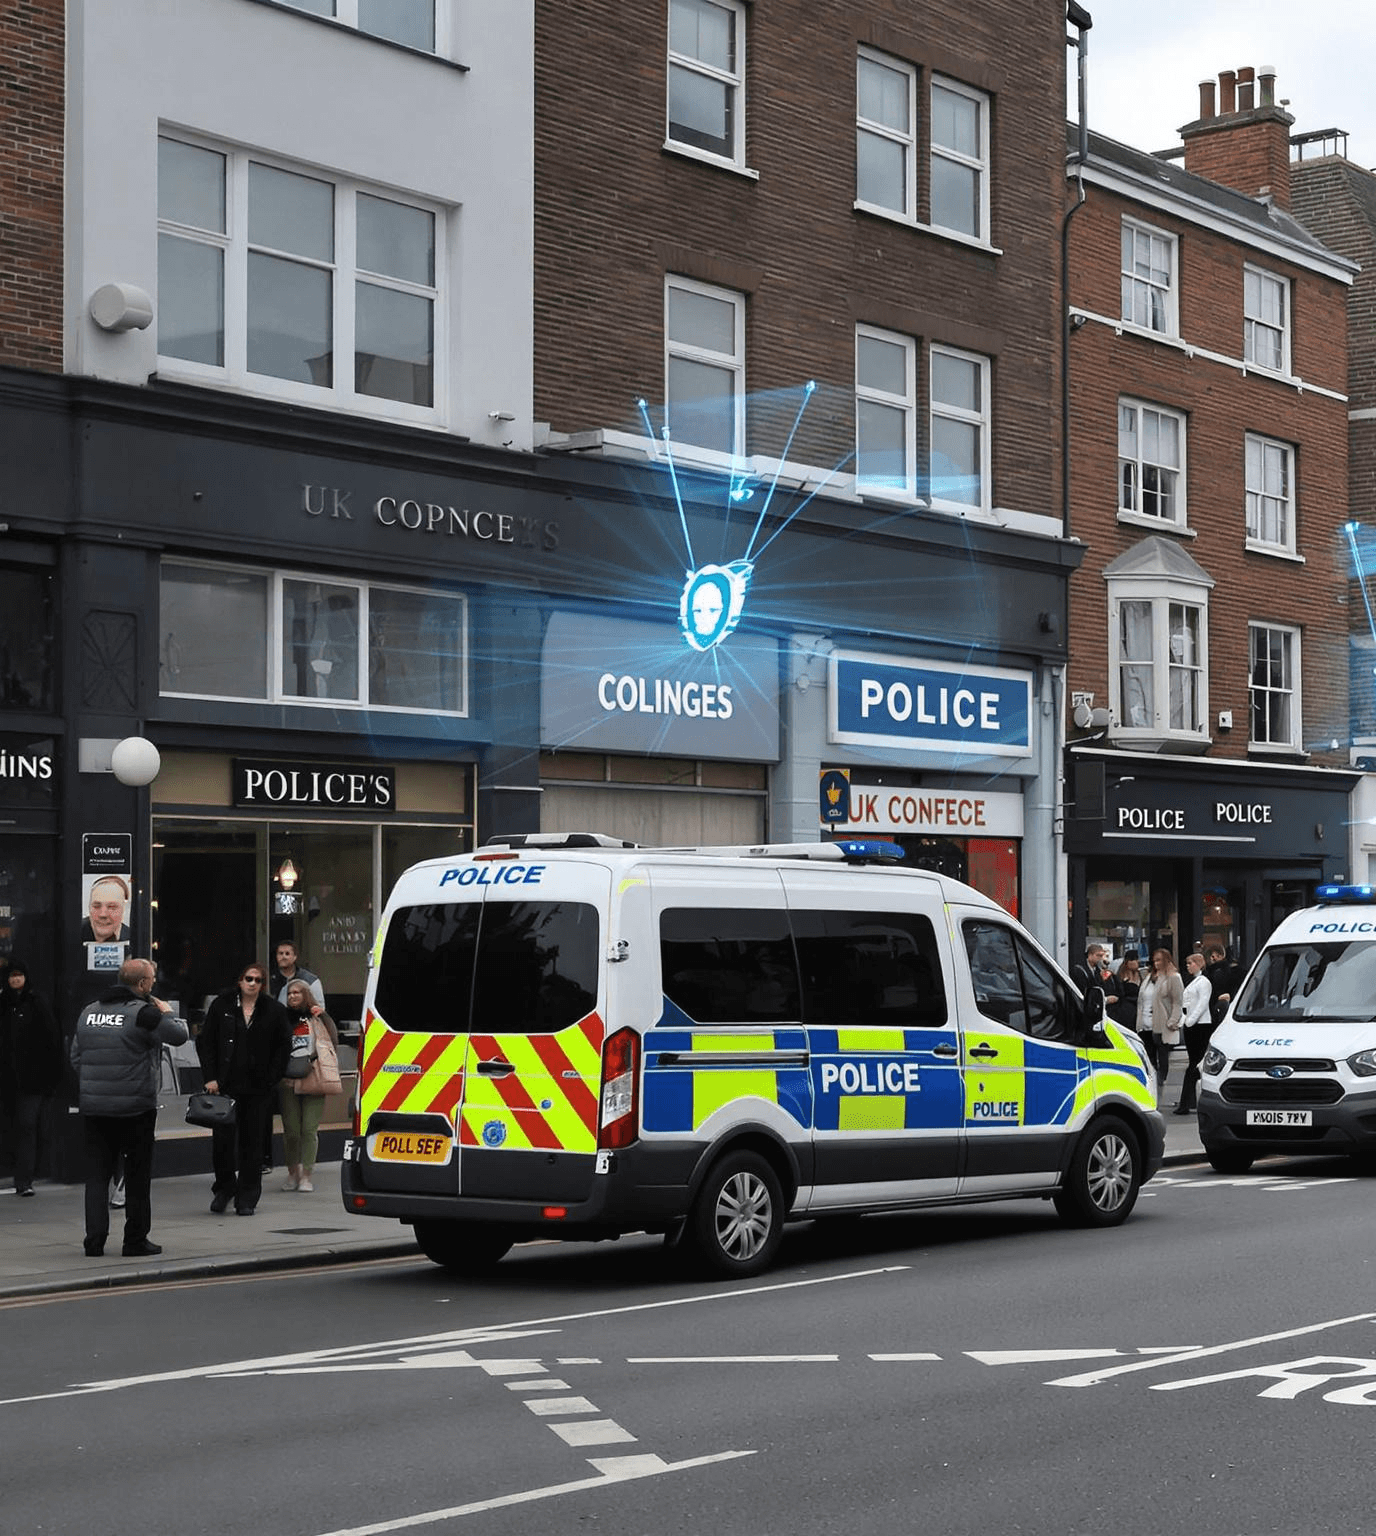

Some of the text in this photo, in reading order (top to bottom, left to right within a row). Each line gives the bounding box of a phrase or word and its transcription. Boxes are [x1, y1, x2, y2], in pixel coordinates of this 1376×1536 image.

[303, 485, 354, 519] UK
[598, 673, 733, 719] COLINGES
[861, 679, 1000, 730] POLICE
[244, 769, 391, 805] POLICE'S
[848, 795, 986, 826] UK CONFECE
[1118, 803, 1272, 829] POLICE POLICE
[439, 865, 546, 887] POLICE
[821, 1062, 921, 1093] POLICE
[973, 1101, 1018, 1118] POLICE
